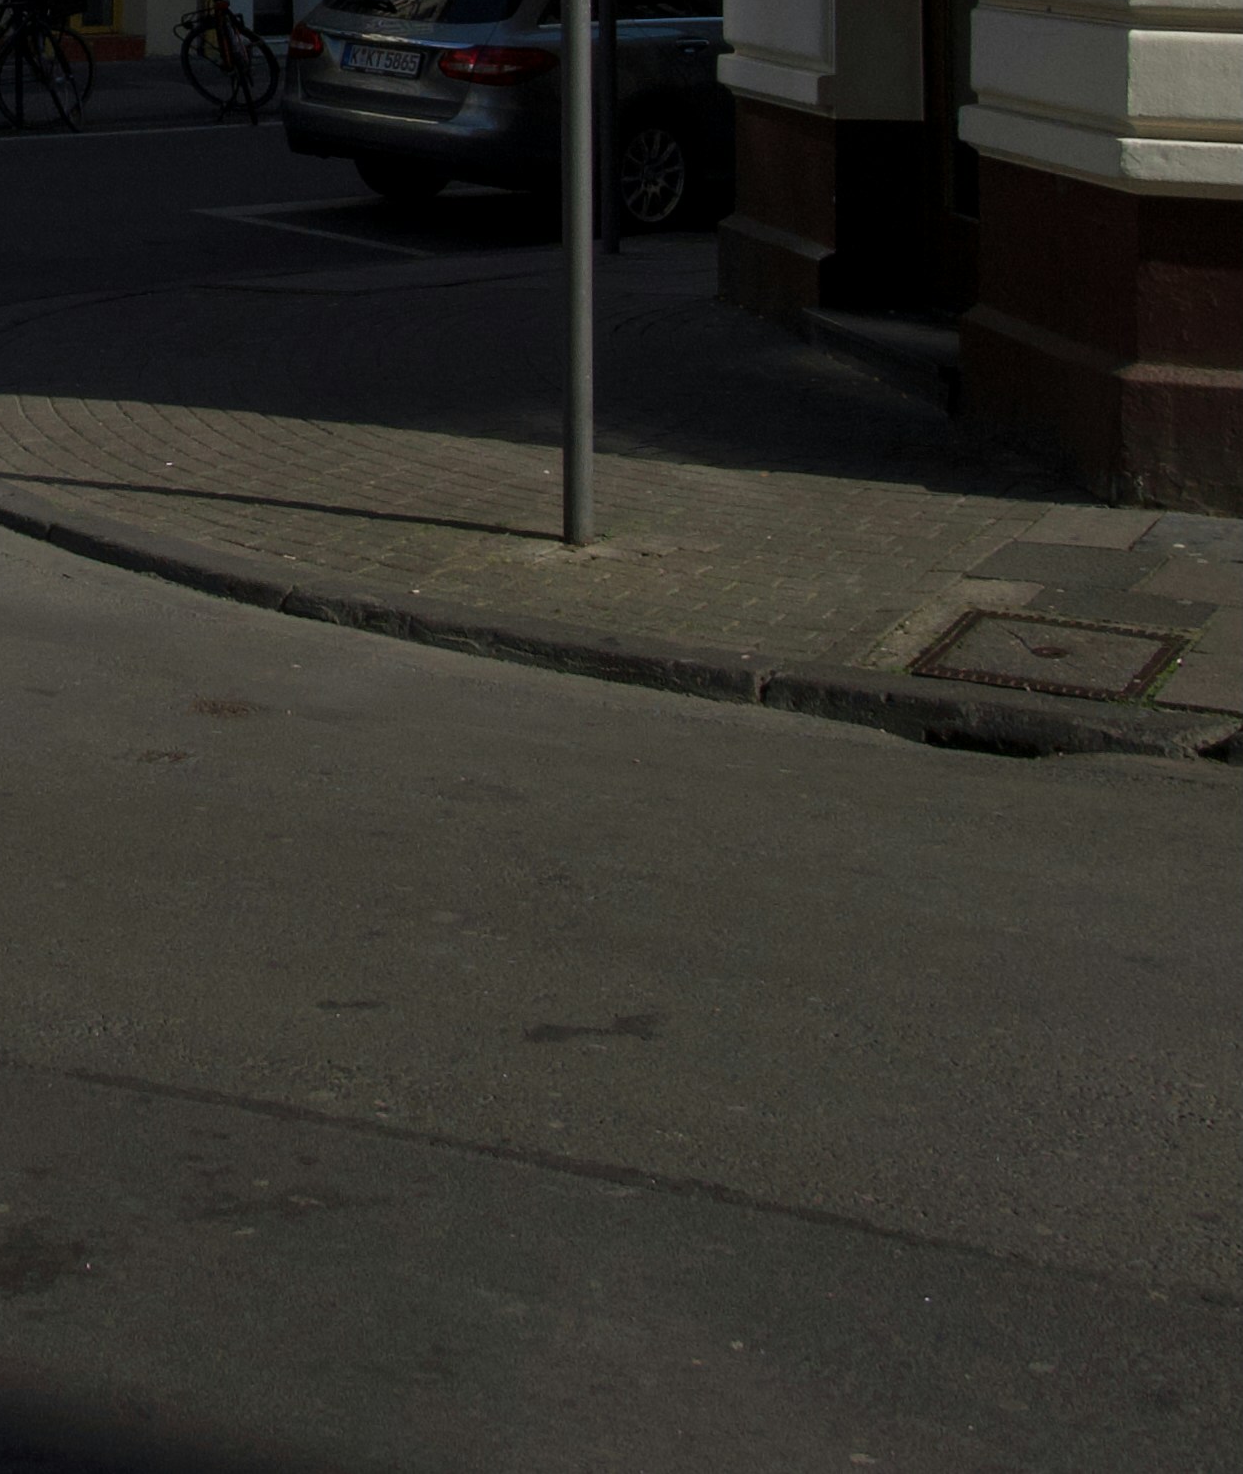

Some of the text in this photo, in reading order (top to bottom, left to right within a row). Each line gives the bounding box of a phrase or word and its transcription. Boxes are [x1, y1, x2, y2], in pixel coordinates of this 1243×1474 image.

[350, 46, 420, 72] K KT 5865
